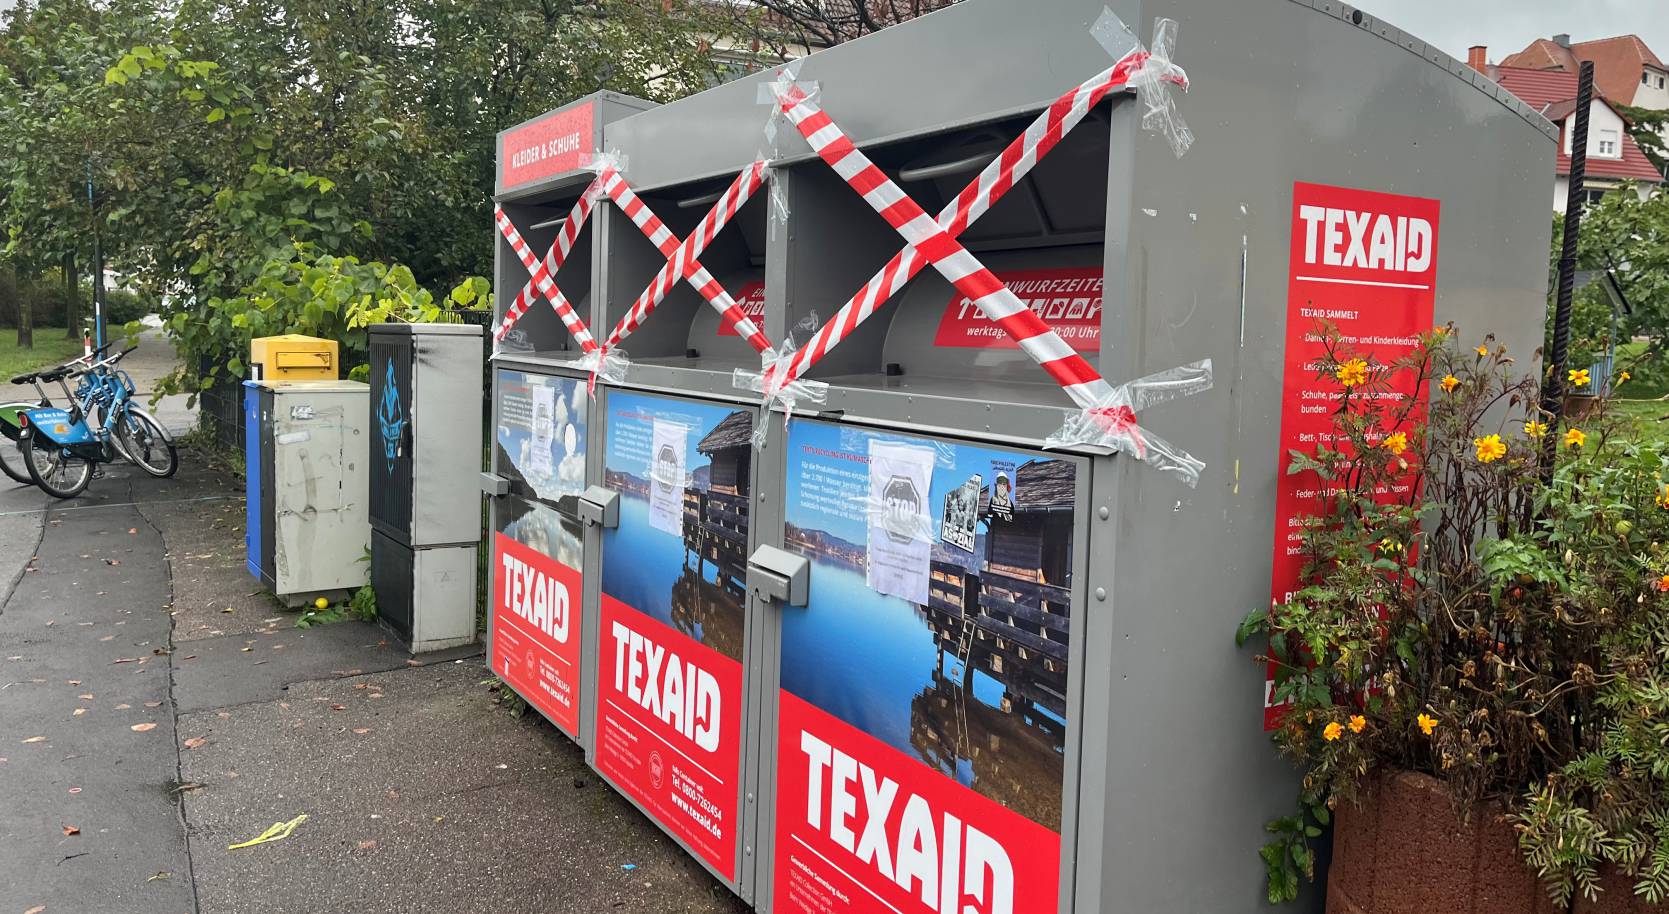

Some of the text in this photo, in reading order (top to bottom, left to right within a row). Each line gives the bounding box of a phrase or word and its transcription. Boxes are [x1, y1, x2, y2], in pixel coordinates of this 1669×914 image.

[512, 131, 580, 169] KLEIDER & SCHUHE
[1299, 204, 1433, 273] TEXAID
[1300, 307, 1359, 320] TEXAID SAMMELT
[966, 326, 1007, 341] werktags
[1078, 326, 1100, 339] Uhr
[1360, 336, 1373, 344] und
[1373, 335, 1419, 348] Kinderkleidung
[1301, 390, 1328, 401] Schuhe,
[1301, 404, 1327, 414] bunden
[1299, 433, 1318, 443] Bett-,
[1296, 488, 1316, 498] Feder-
[502, 552, 570, 645] TEXAID
[612, 620, 722, 753] TEXAID
[671, 773, 722, 821] Tel. 0800-7262454
[671, 792, 722, 840] www.texaid.de
[800, 729, 1014, 914] TEXAID
